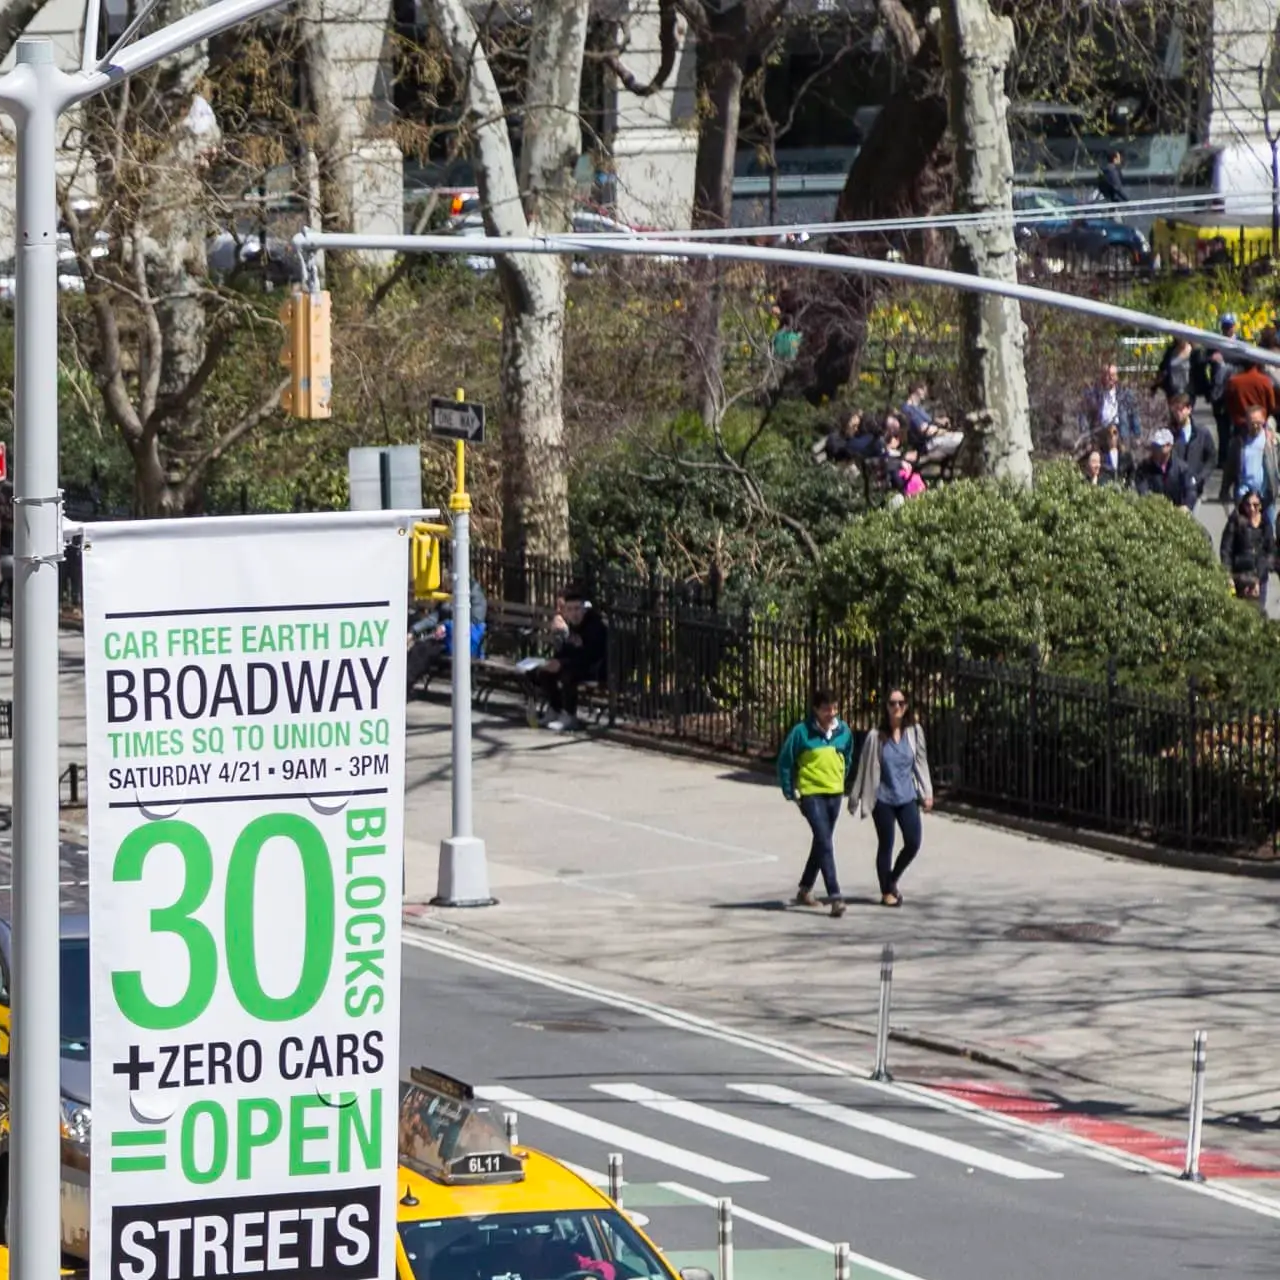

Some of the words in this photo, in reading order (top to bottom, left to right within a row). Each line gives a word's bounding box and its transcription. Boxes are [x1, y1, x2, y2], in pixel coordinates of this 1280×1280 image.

[104, 631, 158, 660] CAR
[168, 626, 232, 657] FREE
[242, 623, 329, 654] EARTH
[340, 619, 389, 650] DAY
[106, 656, 389, 724] BROADWAY
[108, 729, 184, 759] TIMES
[192, 726, 224, 755] SQ
[235, 725, 264, 752] TO
[273, 721, 351, 750] UNION
[360, 718, 389, 747] SQ
[109, 763, 211, 790] SATURDAY
[219, 760, 262, 785] 4/21
[282, 757, 327, 782] 9AM
[349, 754, 389, 778] 3PM
[111, 811, 336, 1030] 30
[344, 806, 388, 1018] BLOCKS
[113, 1039, 263, 1092] +ZERO
[279, 1030, 385, 1081] CARS
[111, 1088, 383, 1185] =OPEN
[469, 1156, 500, 1172] 6L11
